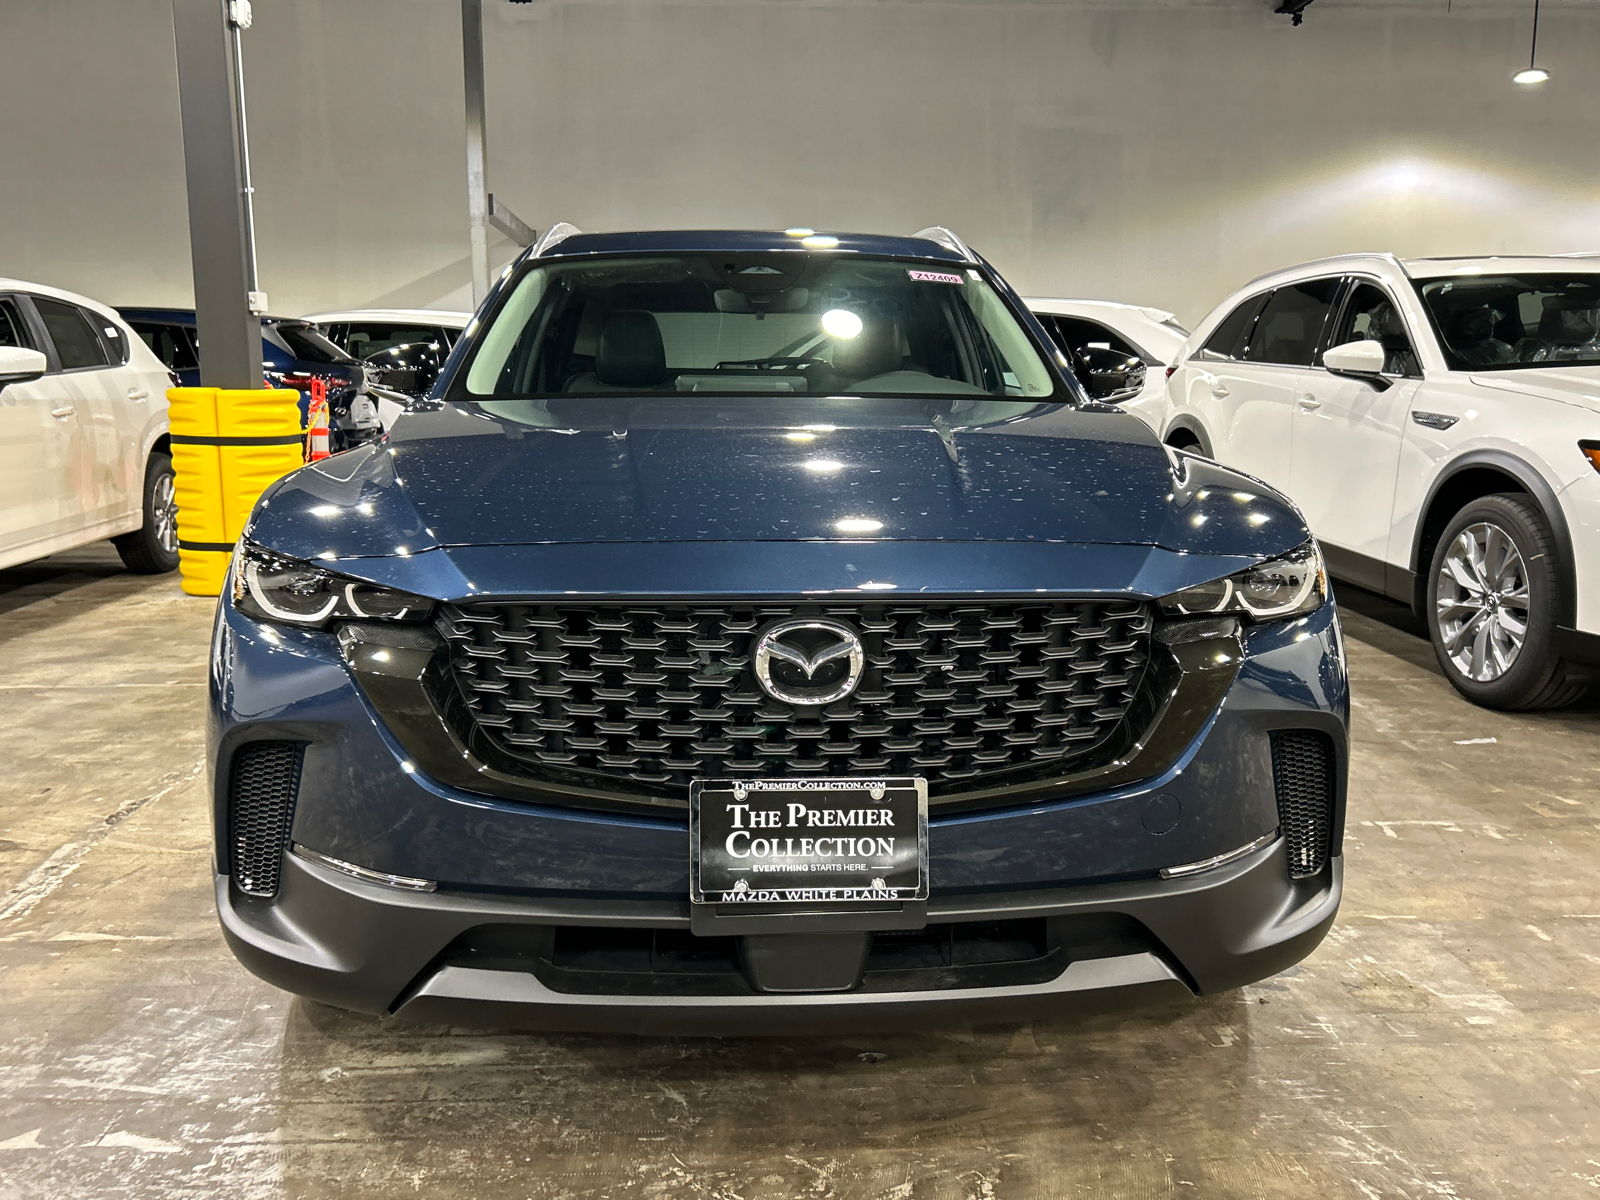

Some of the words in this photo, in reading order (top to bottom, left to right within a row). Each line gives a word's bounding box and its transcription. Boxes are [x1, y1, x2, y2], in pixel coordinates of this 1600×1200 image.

[752, 864, 809, 873] EVERYTHING
[810, 864, 842, 872] STARTS
[843, 863, 869, 871] HERE.
[722, 891, 780, 902] MAZDA
[785, 889, 837, 901] WHITE
[844, 889, 898, 900] PLAINS
